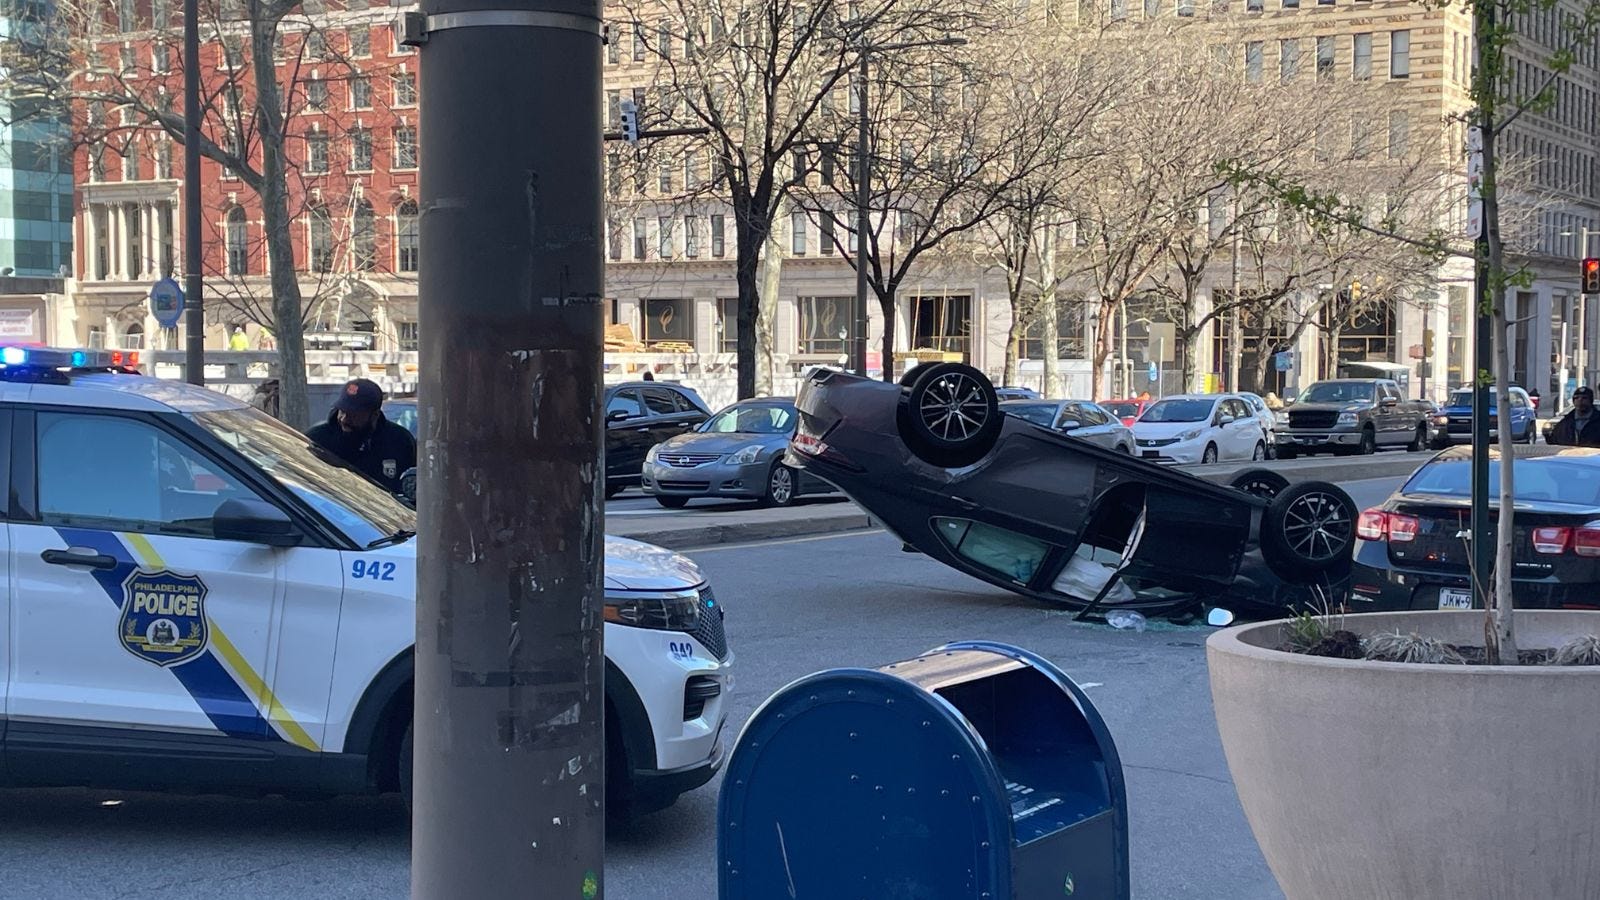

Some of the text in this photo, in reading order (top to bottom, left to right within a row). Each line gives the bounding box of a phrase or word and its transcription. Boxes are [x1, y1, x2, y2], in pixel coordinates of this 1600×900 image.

[351, 560, 396, 581] 942
[134, 583, 199, 593] PHILADELPHIA
[133, 592, 199, 616] POLICE
[669, 641, 696, 661] 942
